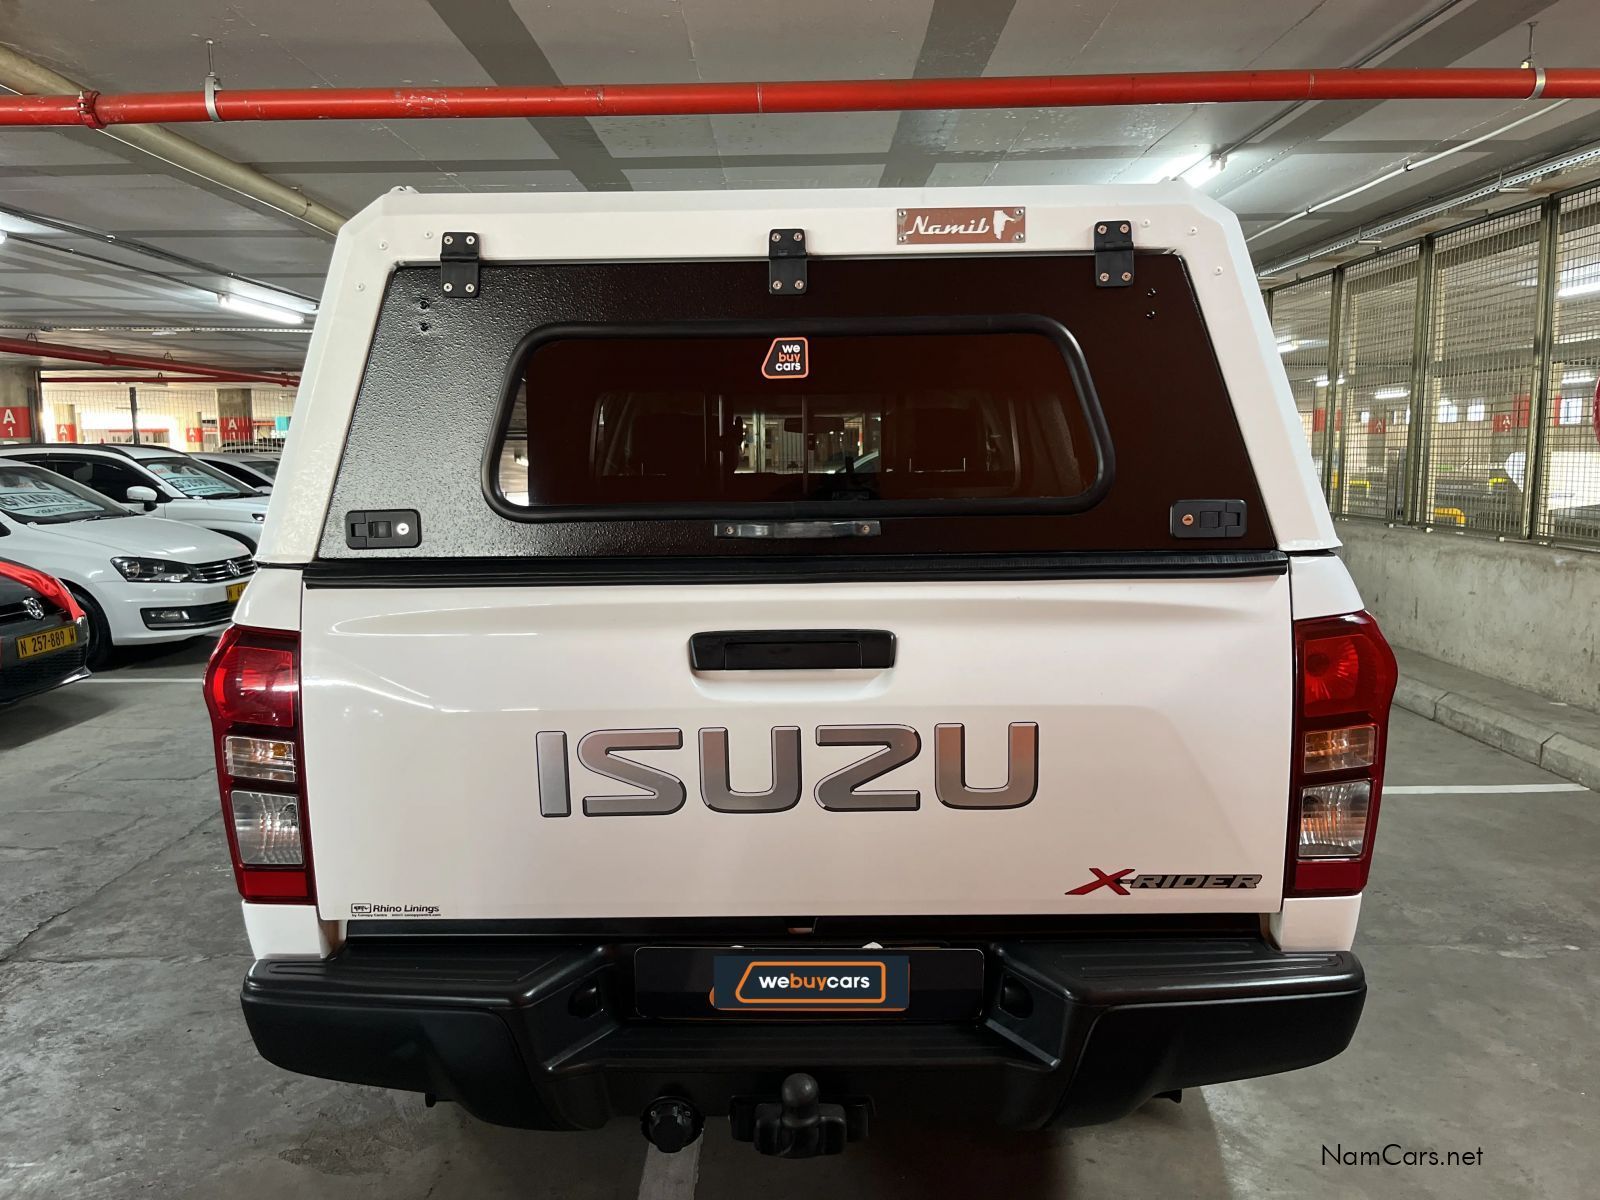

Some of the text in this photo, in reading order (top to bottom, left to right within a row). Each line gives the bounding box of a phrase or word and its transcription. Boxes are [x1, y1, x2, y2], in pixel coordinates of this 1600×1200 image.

[906, 215, 990, 235] Namib
[781, 344, 801, 353] we
[778, 352, 801, 363] buy
[775, 362, 801, 371] cars
[3, 409, 16, 425] A
[60, 426, 67, 434] A
[228, 419, 237, 430] A
[8, 426, 14, 437] 1
[19, 627, 76, 656] N 257-889 W
[535, 721, 1039, 818] ISUZU
[1064, 867, 1264, 896] X-RIDER
[373, 904, 440, 914] Rhino Linings
